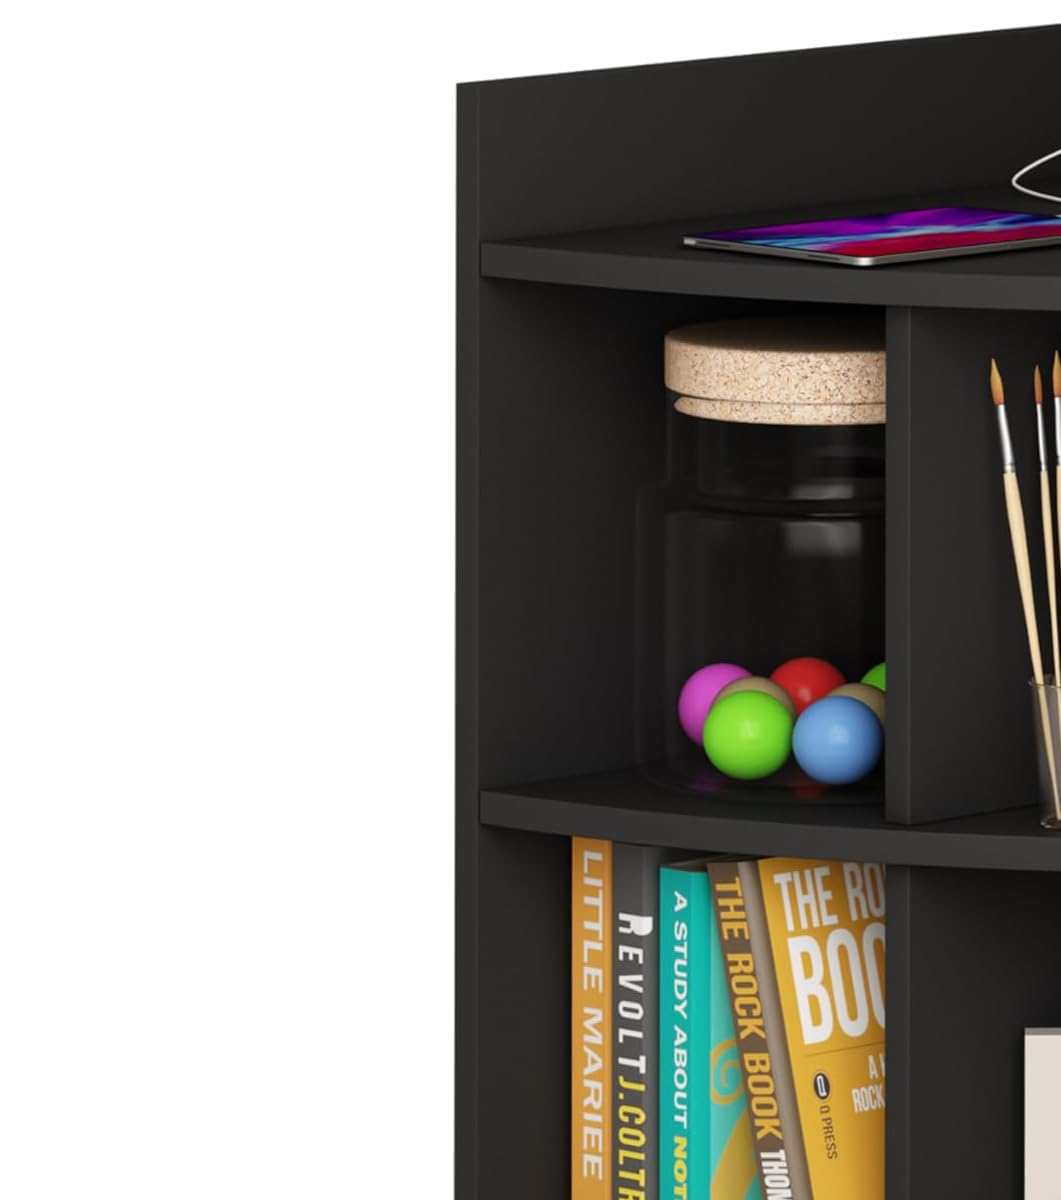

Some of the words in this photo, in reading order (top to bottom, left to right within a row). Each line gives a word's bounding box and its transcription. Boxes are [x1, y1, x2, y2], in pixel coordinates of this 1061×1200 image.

[582, 850, 603, 993] LITTLE
[673, 891, 688, 912] A
[715, 876, 750, 941] THE
[773, 866, 838, 932] THE
[842, 862, 886, 922] RO
[618, 912, 653, 1075] REVOLT
[673, 920, 688, 1019] STUDY
[727, 953, 766, 1039] ROCK
[582, 1007, 603, 1181] MARIEE
[673, 1025, 688, 1129] ABOUT
[743, 1052, 783, 1141] BOOK
[851, 1083, 886, 1113] ROCK
[821, 1117, 838, 1160] PRESS
